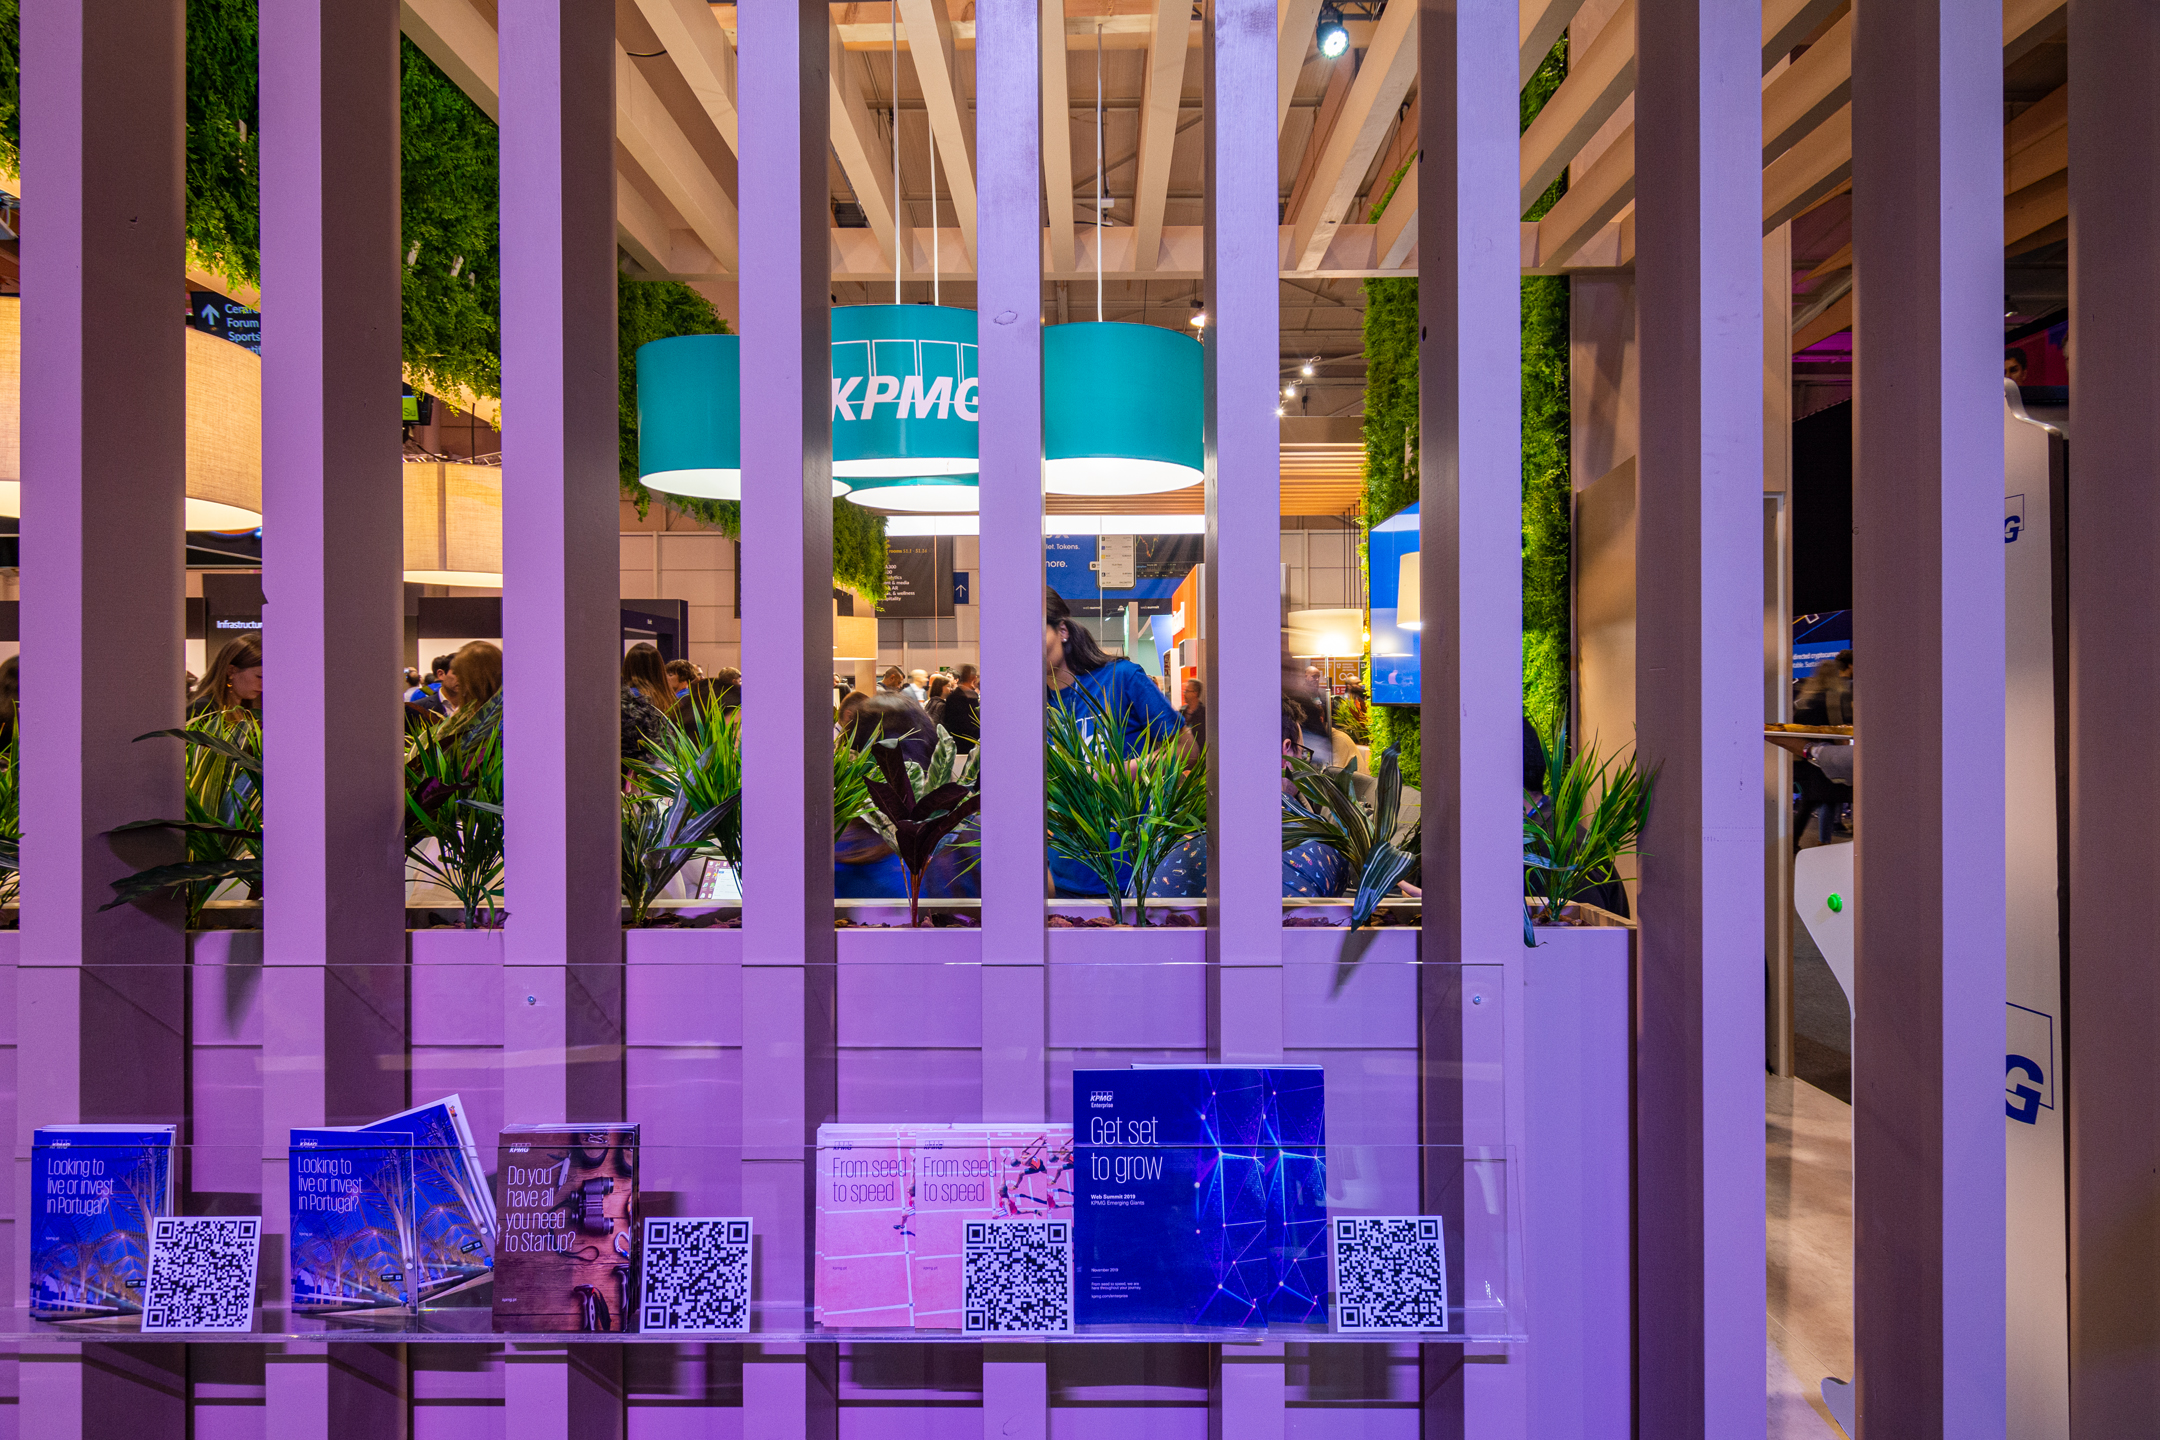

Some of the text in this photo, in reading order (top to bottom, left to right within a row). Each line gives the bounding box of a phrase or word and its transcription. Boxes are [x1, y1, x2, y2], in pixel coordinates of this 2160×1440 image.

[226, 317, 259, 328] Forum
[228, 331, 262, 343] Sports
[832, 375, 979, 422] KPMG
[216, 620, 263, 629] Infrastructur
[1090, 1116, 1159, 1145] Get set
[47, 1157, 105, 1178] Looking to
[297, 1156, 352, 1176] Looking to
[507, 1165, 552, 1188] Do you
[832, 1156, 907, 1179] From seed
[923, 1156, 997, 1178] From seed
[1090, 1152, 1163, 1184] to grow
[47, 1176, 115, 1196] live or invest
[298, 1174, 363, 1194] live or invest
[832, 1180, 895, 1204] to speed
[923, 1180, 985, 1204] to speed
[46, 1195, 110, 1217] in Portugal?
[298, 1193, 360, 1214] in Portugal?
[506, 1187, 555, 1208] have all
[505, 1209, 566, 1232] you need
[504, 1232, 519, 1252] to
[520, 1230, 576, 1254] Startup?
